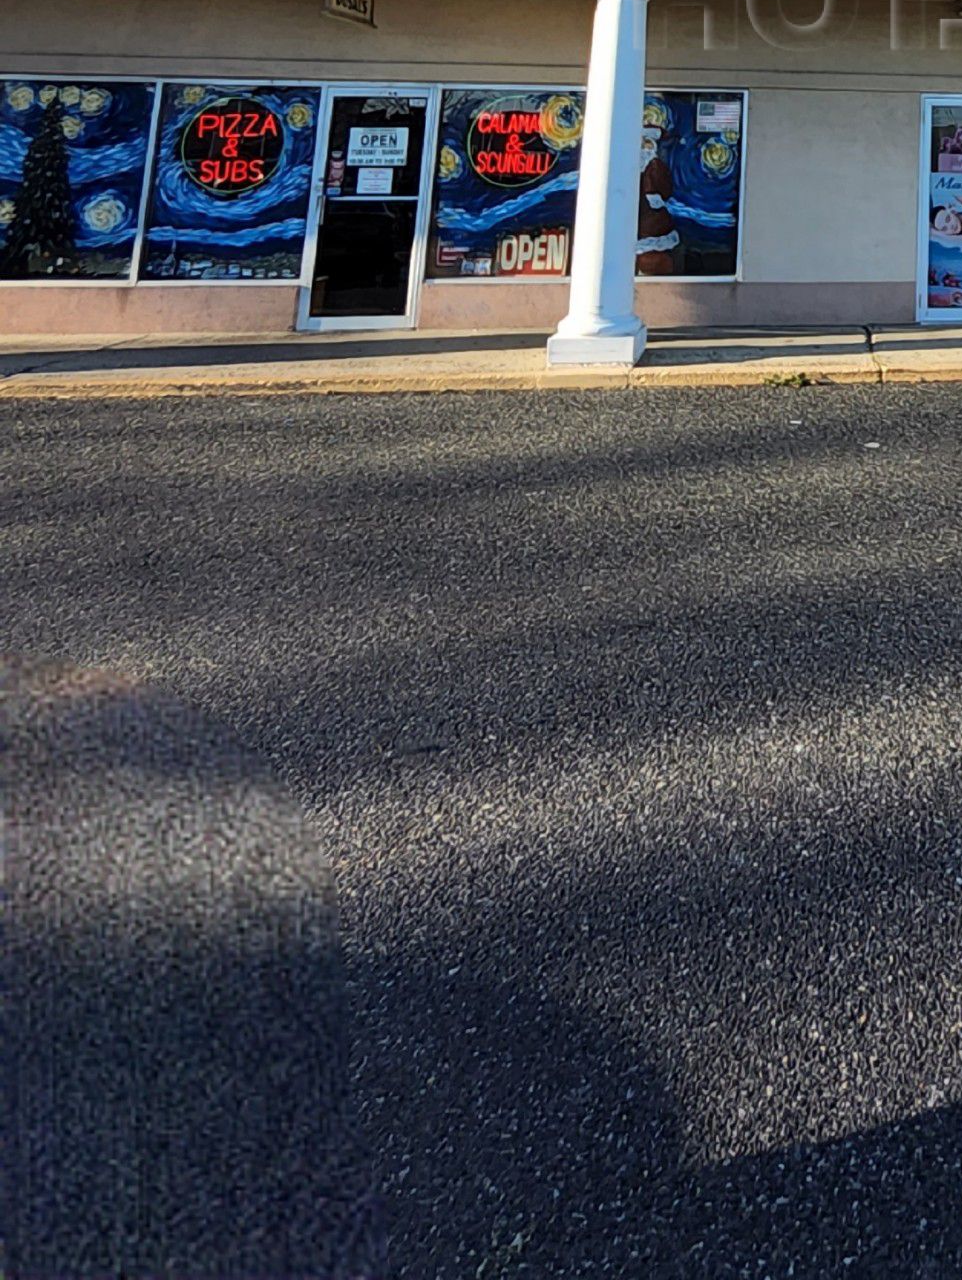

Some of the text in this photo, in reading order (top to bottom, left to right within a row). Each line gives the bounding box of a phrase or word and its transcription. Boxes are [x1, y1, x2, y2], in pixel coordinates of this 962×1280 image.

[198, 113, 278, 138] PIZZA
[477, 111, 545, 134] CALAMA
[222, 138, 238, 157] &
[361, 134, 398, 148] OPEN
[506, 134, 525, 152] &
[199, 160, 264, 183] SUBS
[500, 233, 565, 271] OPEN
